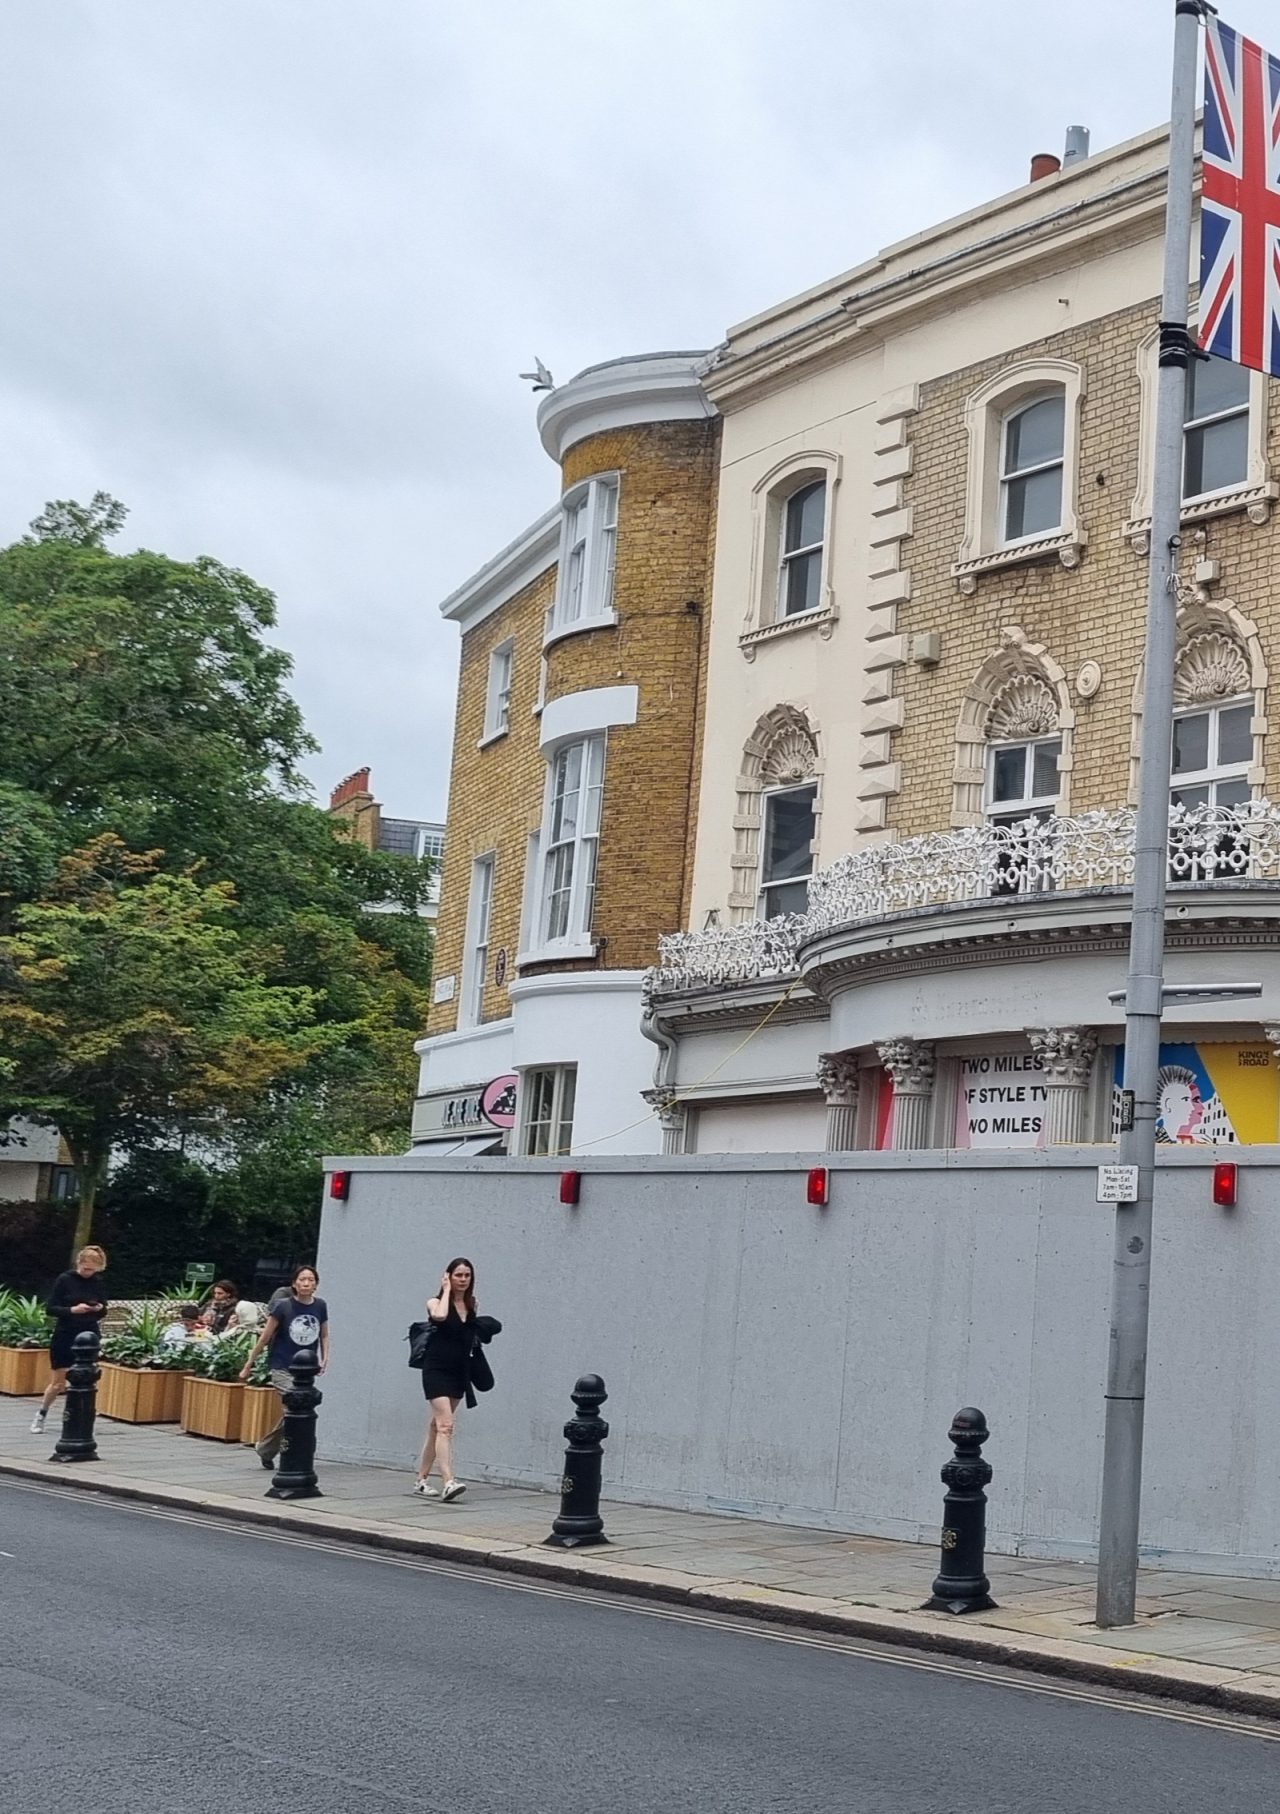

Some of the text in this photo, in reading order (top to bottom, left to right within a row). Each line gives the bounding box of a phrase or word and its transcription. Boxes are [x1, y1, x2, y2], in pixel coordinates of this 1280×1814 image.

[961, 1054, 1044, 1074] TWO MILES
[965, 1088, 977, 1104] F
[979, 1086, 1026, 1104] STYLE
[992, 1116, 1042, 1134] MILES
